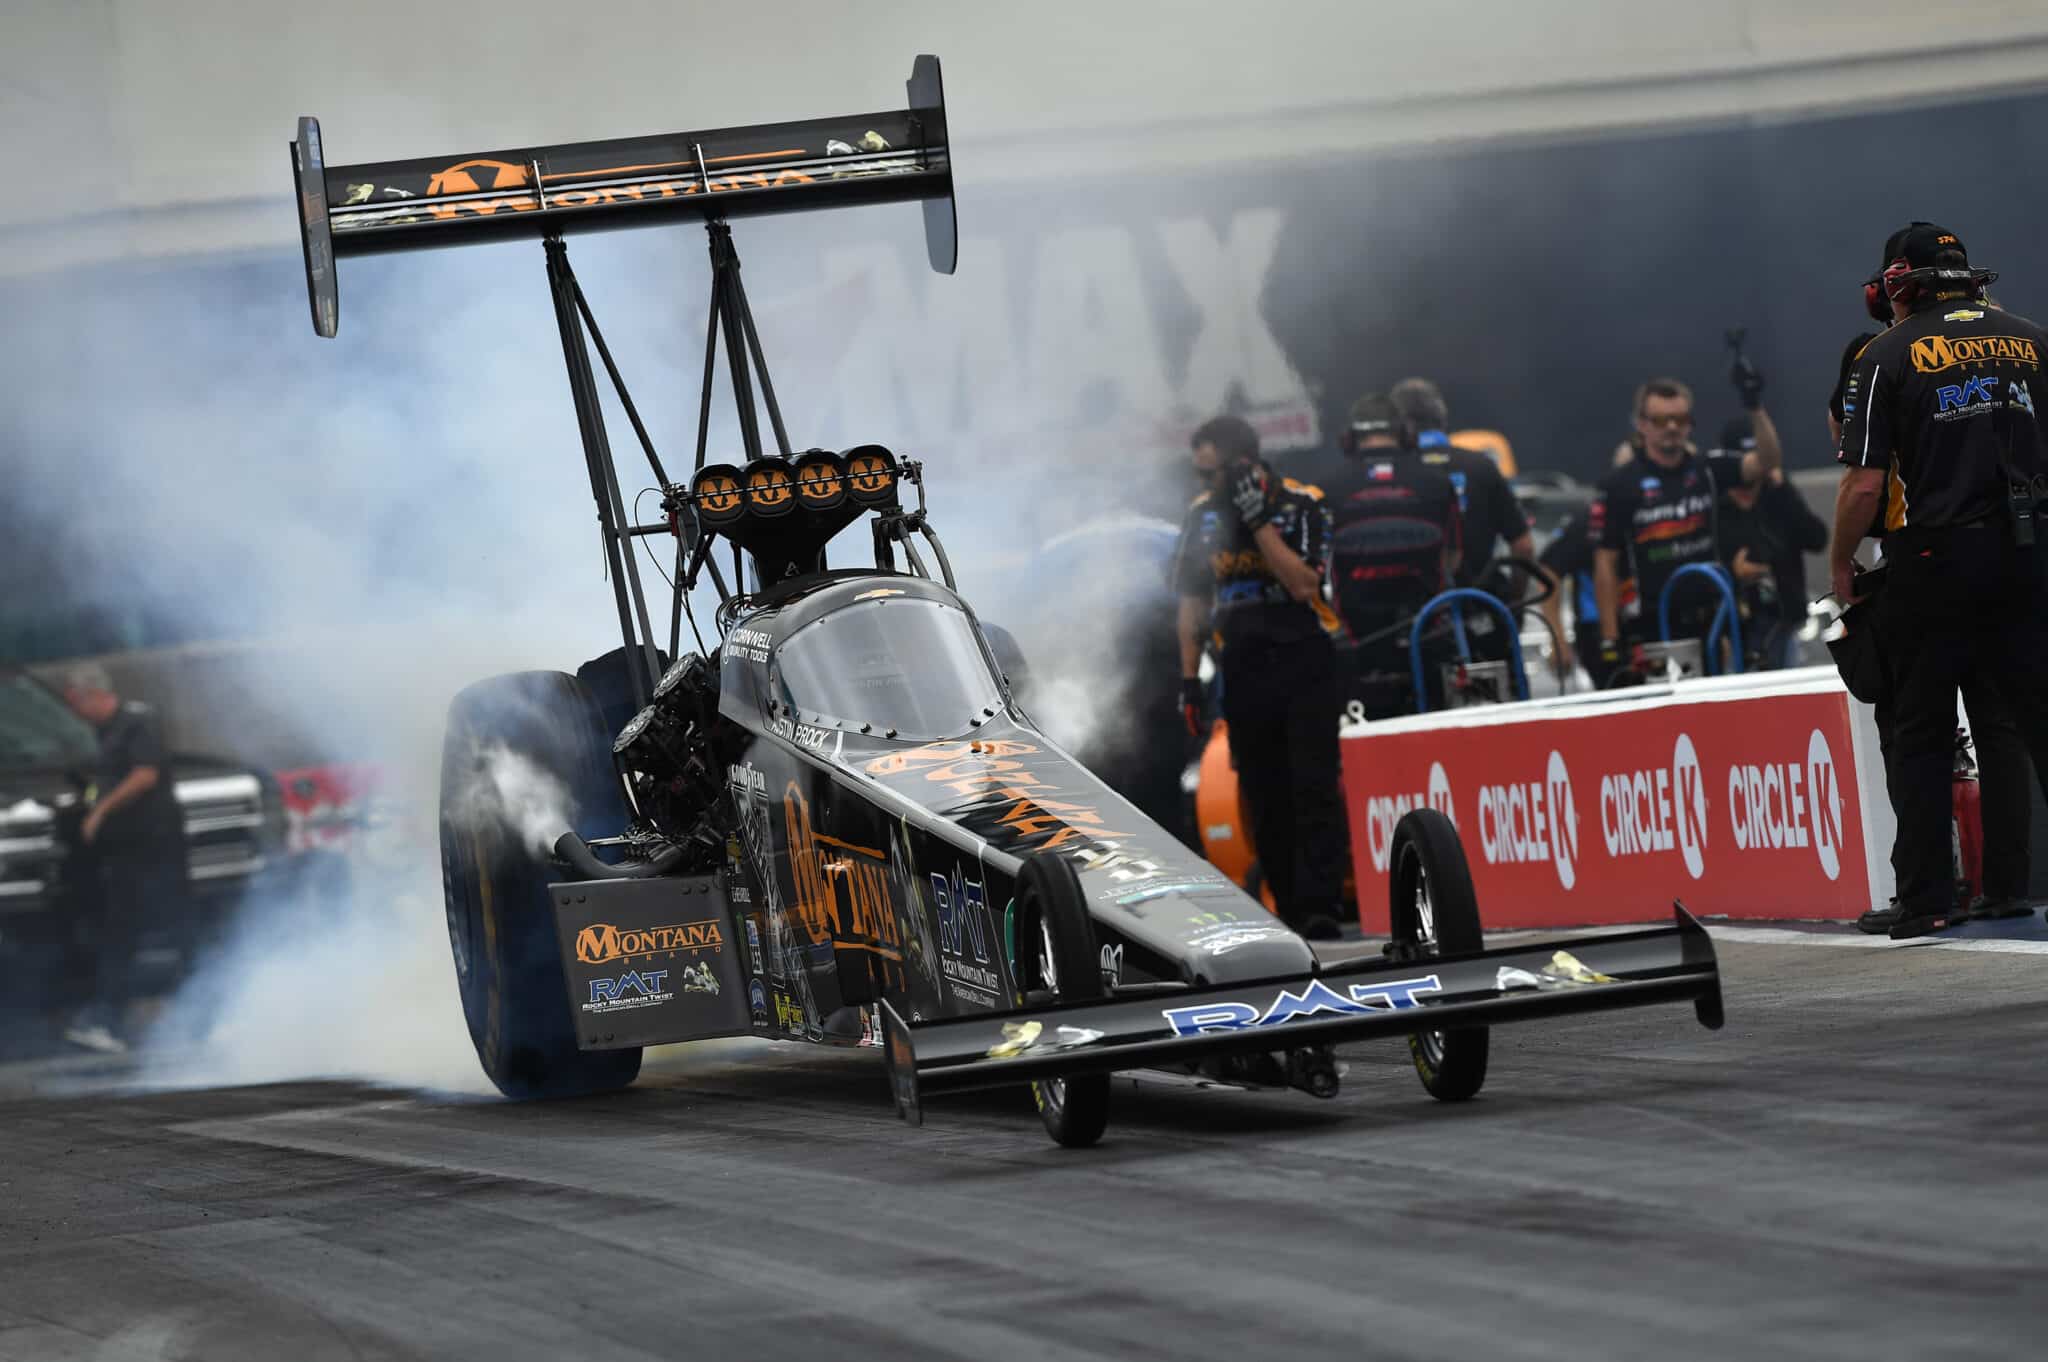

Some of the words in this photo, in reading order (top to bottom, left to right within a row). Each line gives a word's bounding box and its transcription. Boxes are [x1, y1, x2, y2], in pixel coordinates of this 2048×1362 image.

[1911, 336, 2039, 372] MONTANA
[734, 628, 772, 649] CORNWELL
[750, 649, 769, 664] TOOLS
[795, 723, 829, 749] PROCK
[1478, 783, 1550, 864] CIRCLE
[1550, 774, 1578, 866] K
[1601, 769, 1674, 857] CIRCLE
[1677, 758, 1708, 856] K
[1733, 763, 1808, 850] CIRCLE
[1811, 754, 1843, 858] K
[930, 861, 990, 964] RMT
[575, 921, 723, 964] MONTANA
[588, 970, 668, 1002] RMT
[609, 995, 648, 1006] MOUNTAIN
[1162, 975, 1442, 1036] RMT
